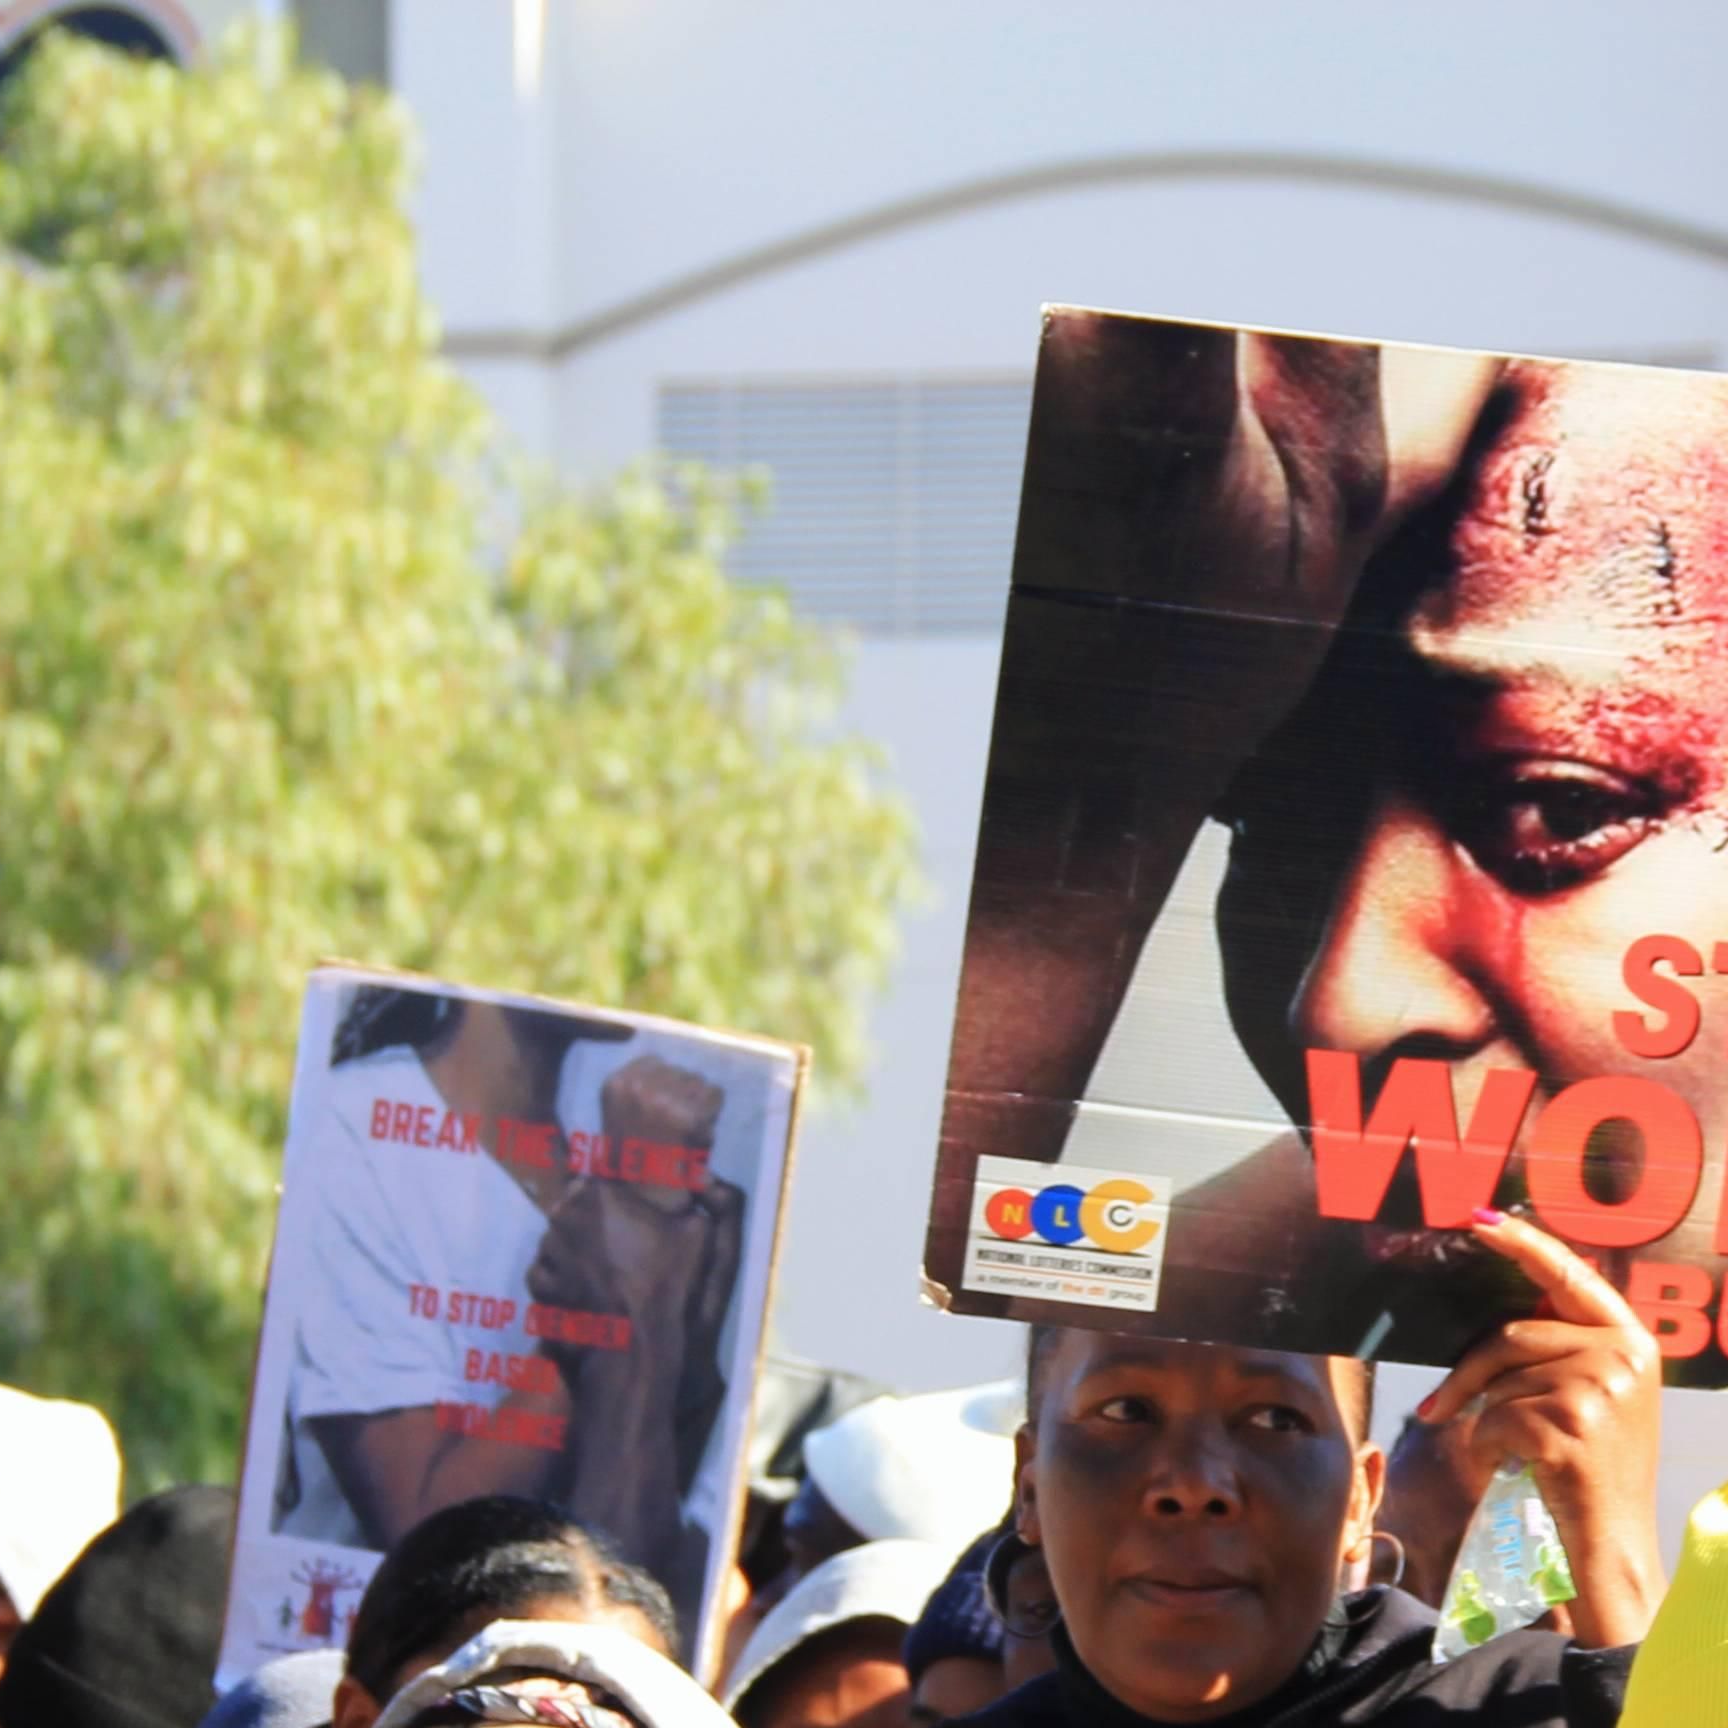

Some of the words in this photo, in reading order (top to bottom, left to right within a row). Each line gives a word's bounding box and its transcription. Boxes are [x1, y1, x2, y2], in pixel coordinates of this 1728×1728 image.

[371, 1097, 480, 1155] BREAK
[496, 1118, 558, 1172] THE
[566, 1131, 710, 1193] SILENCE
[408, 1284, 440, 1321] TO
[447, 1291, 516, 1331] STOP
